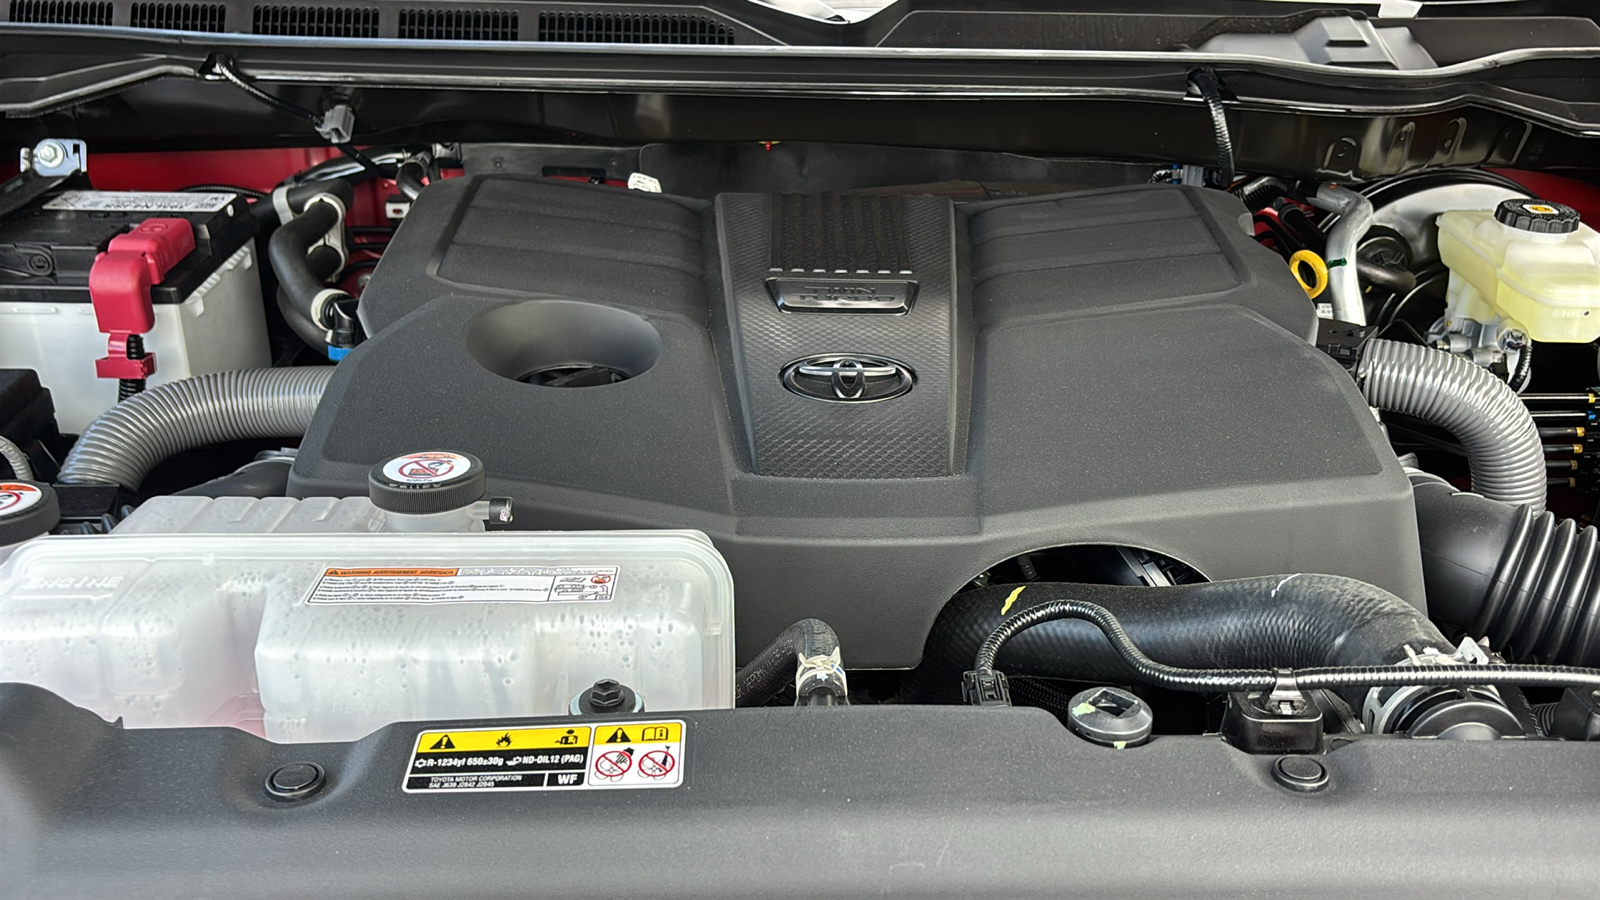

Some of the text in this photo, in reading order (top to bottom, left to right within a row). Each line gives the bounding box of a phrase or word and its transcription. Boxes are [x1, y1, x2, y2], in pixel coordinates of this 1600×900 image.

[426, 754, 584, 768] R-1234yf 650±30g ND-OIL12 (PAG)
[478, 774, 523, 782] CORPORATION
[557, 773, 578, 785] WF
